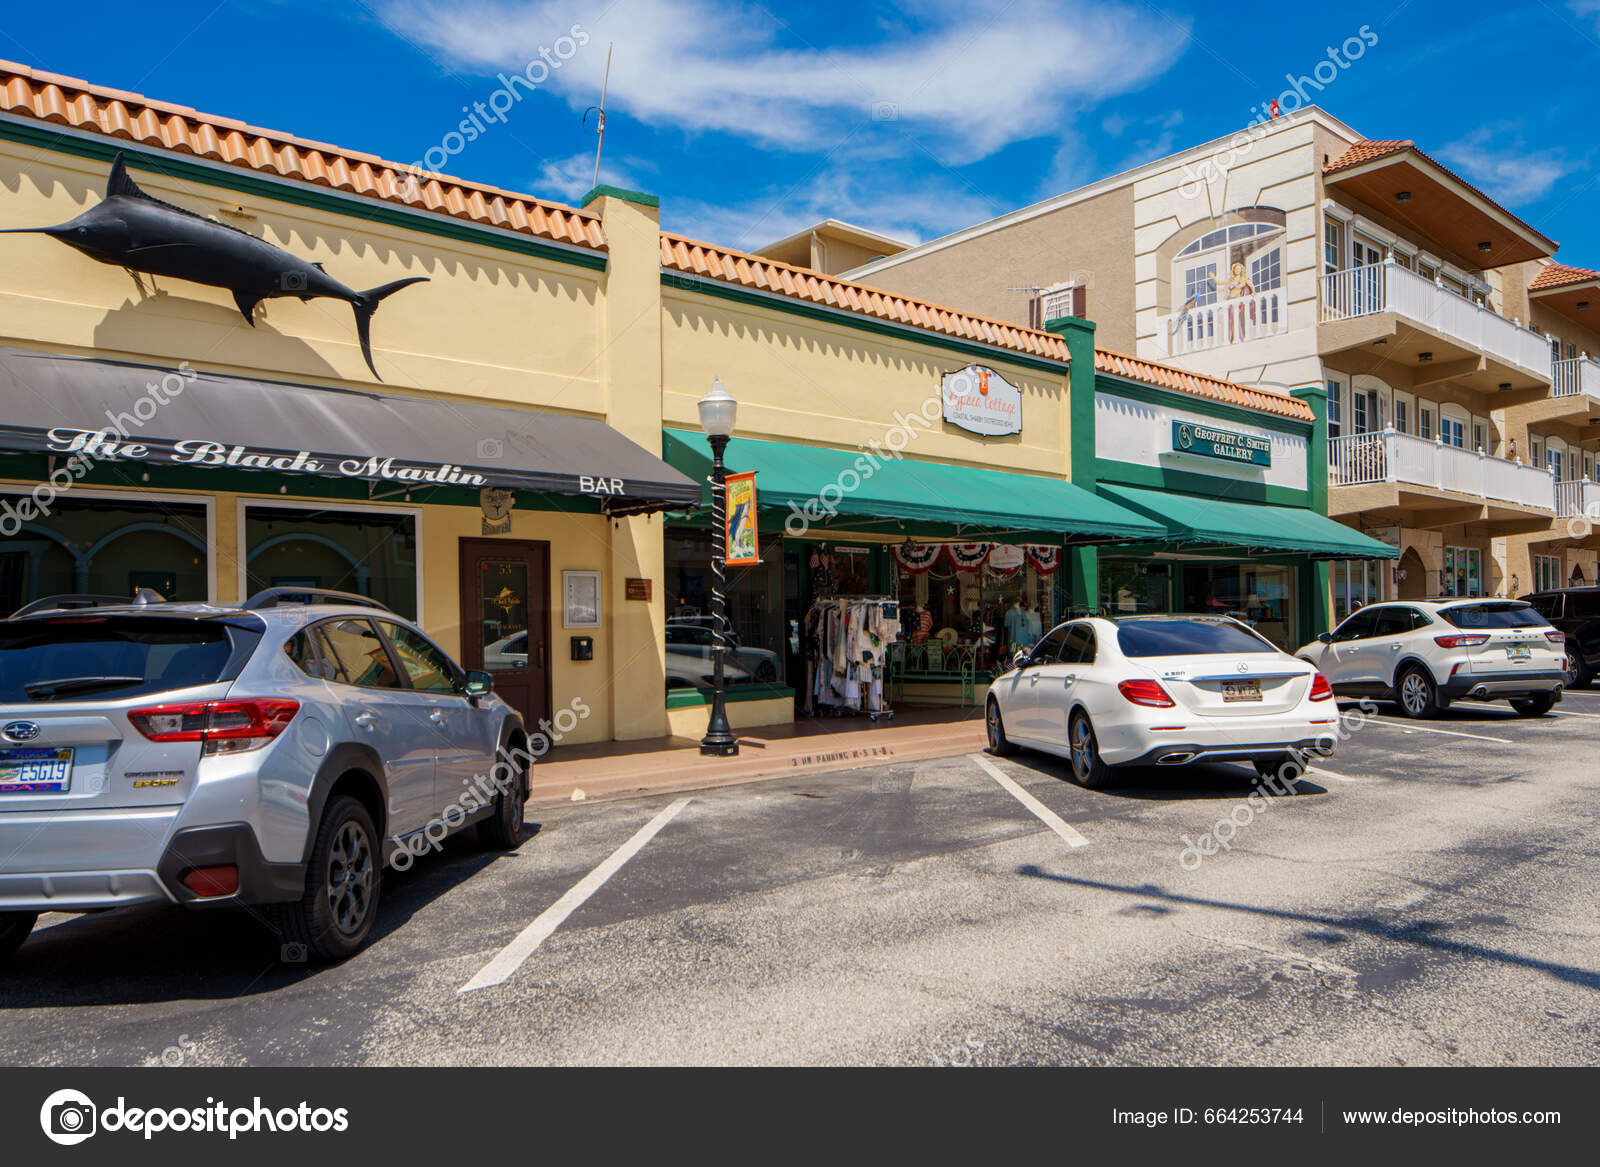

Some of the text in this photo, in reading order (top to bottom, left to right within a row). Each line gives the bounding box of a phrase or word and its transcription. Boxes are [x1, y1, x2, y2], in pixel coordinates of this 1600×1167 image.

[1194, 427, 1270, 452] GEOFFREY C. SMITH
[47, 427, 488, 487] The Black Marlin
[1213, 443, 1253, 460] GALLERY
[579, 475, 625, 495] BAR
[816, 751, 848, 763] PARKING
[133, 778, 179, 788] SPORT
